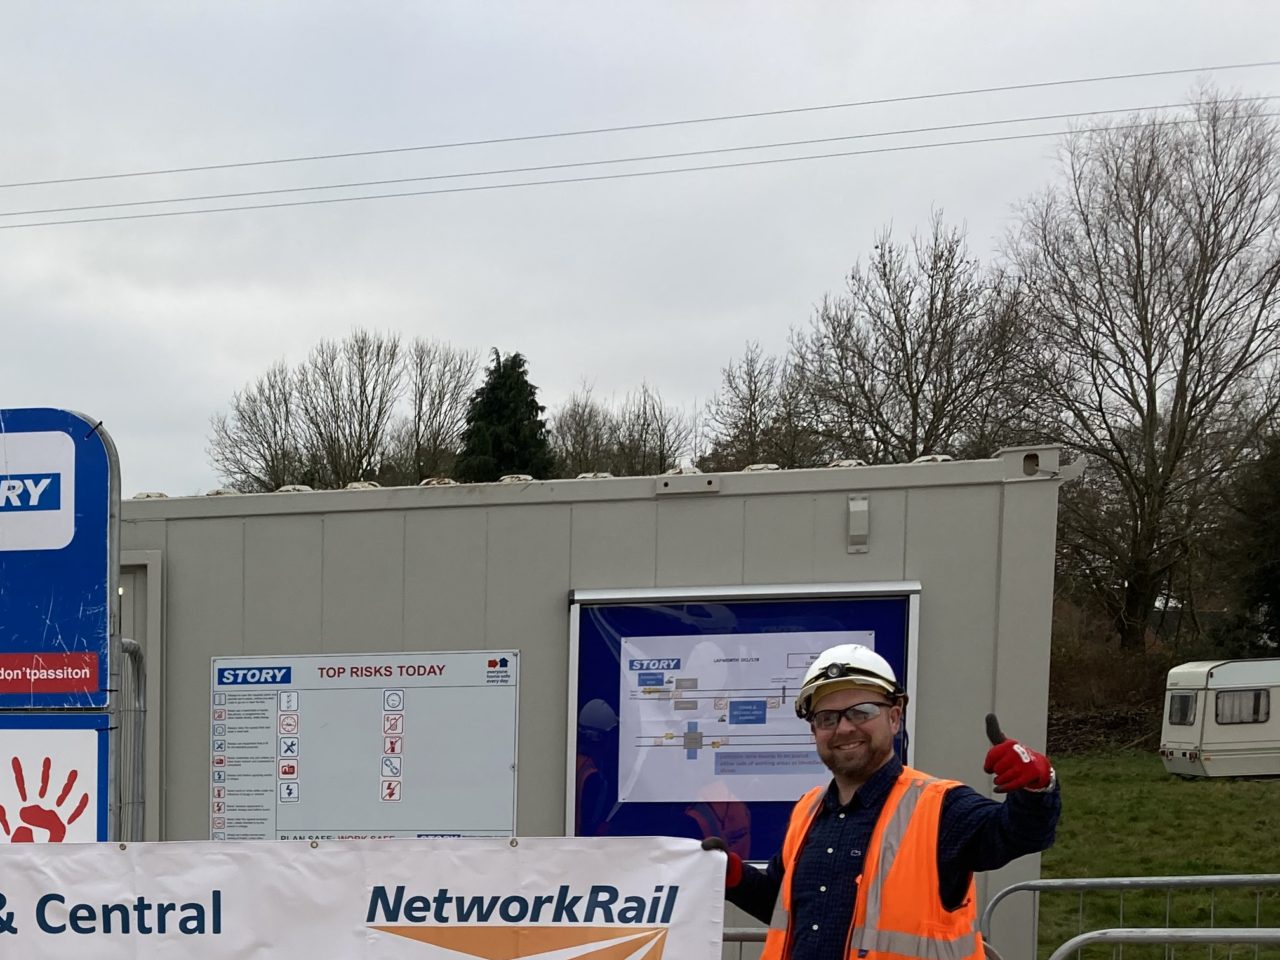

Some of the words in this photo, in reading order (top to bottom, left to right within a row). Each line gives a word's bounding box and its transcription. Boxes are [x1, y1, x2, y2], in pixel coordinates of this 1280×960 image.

[317, 667, 346, 678] TOP
[350, 666, 393, 678] RISKS
[397, 665, 446, 677] TODAY
[632, 659, 678, 671] STORY
[222, 668, 287, 684] STORY
[35, 889, 222, 935] Central
